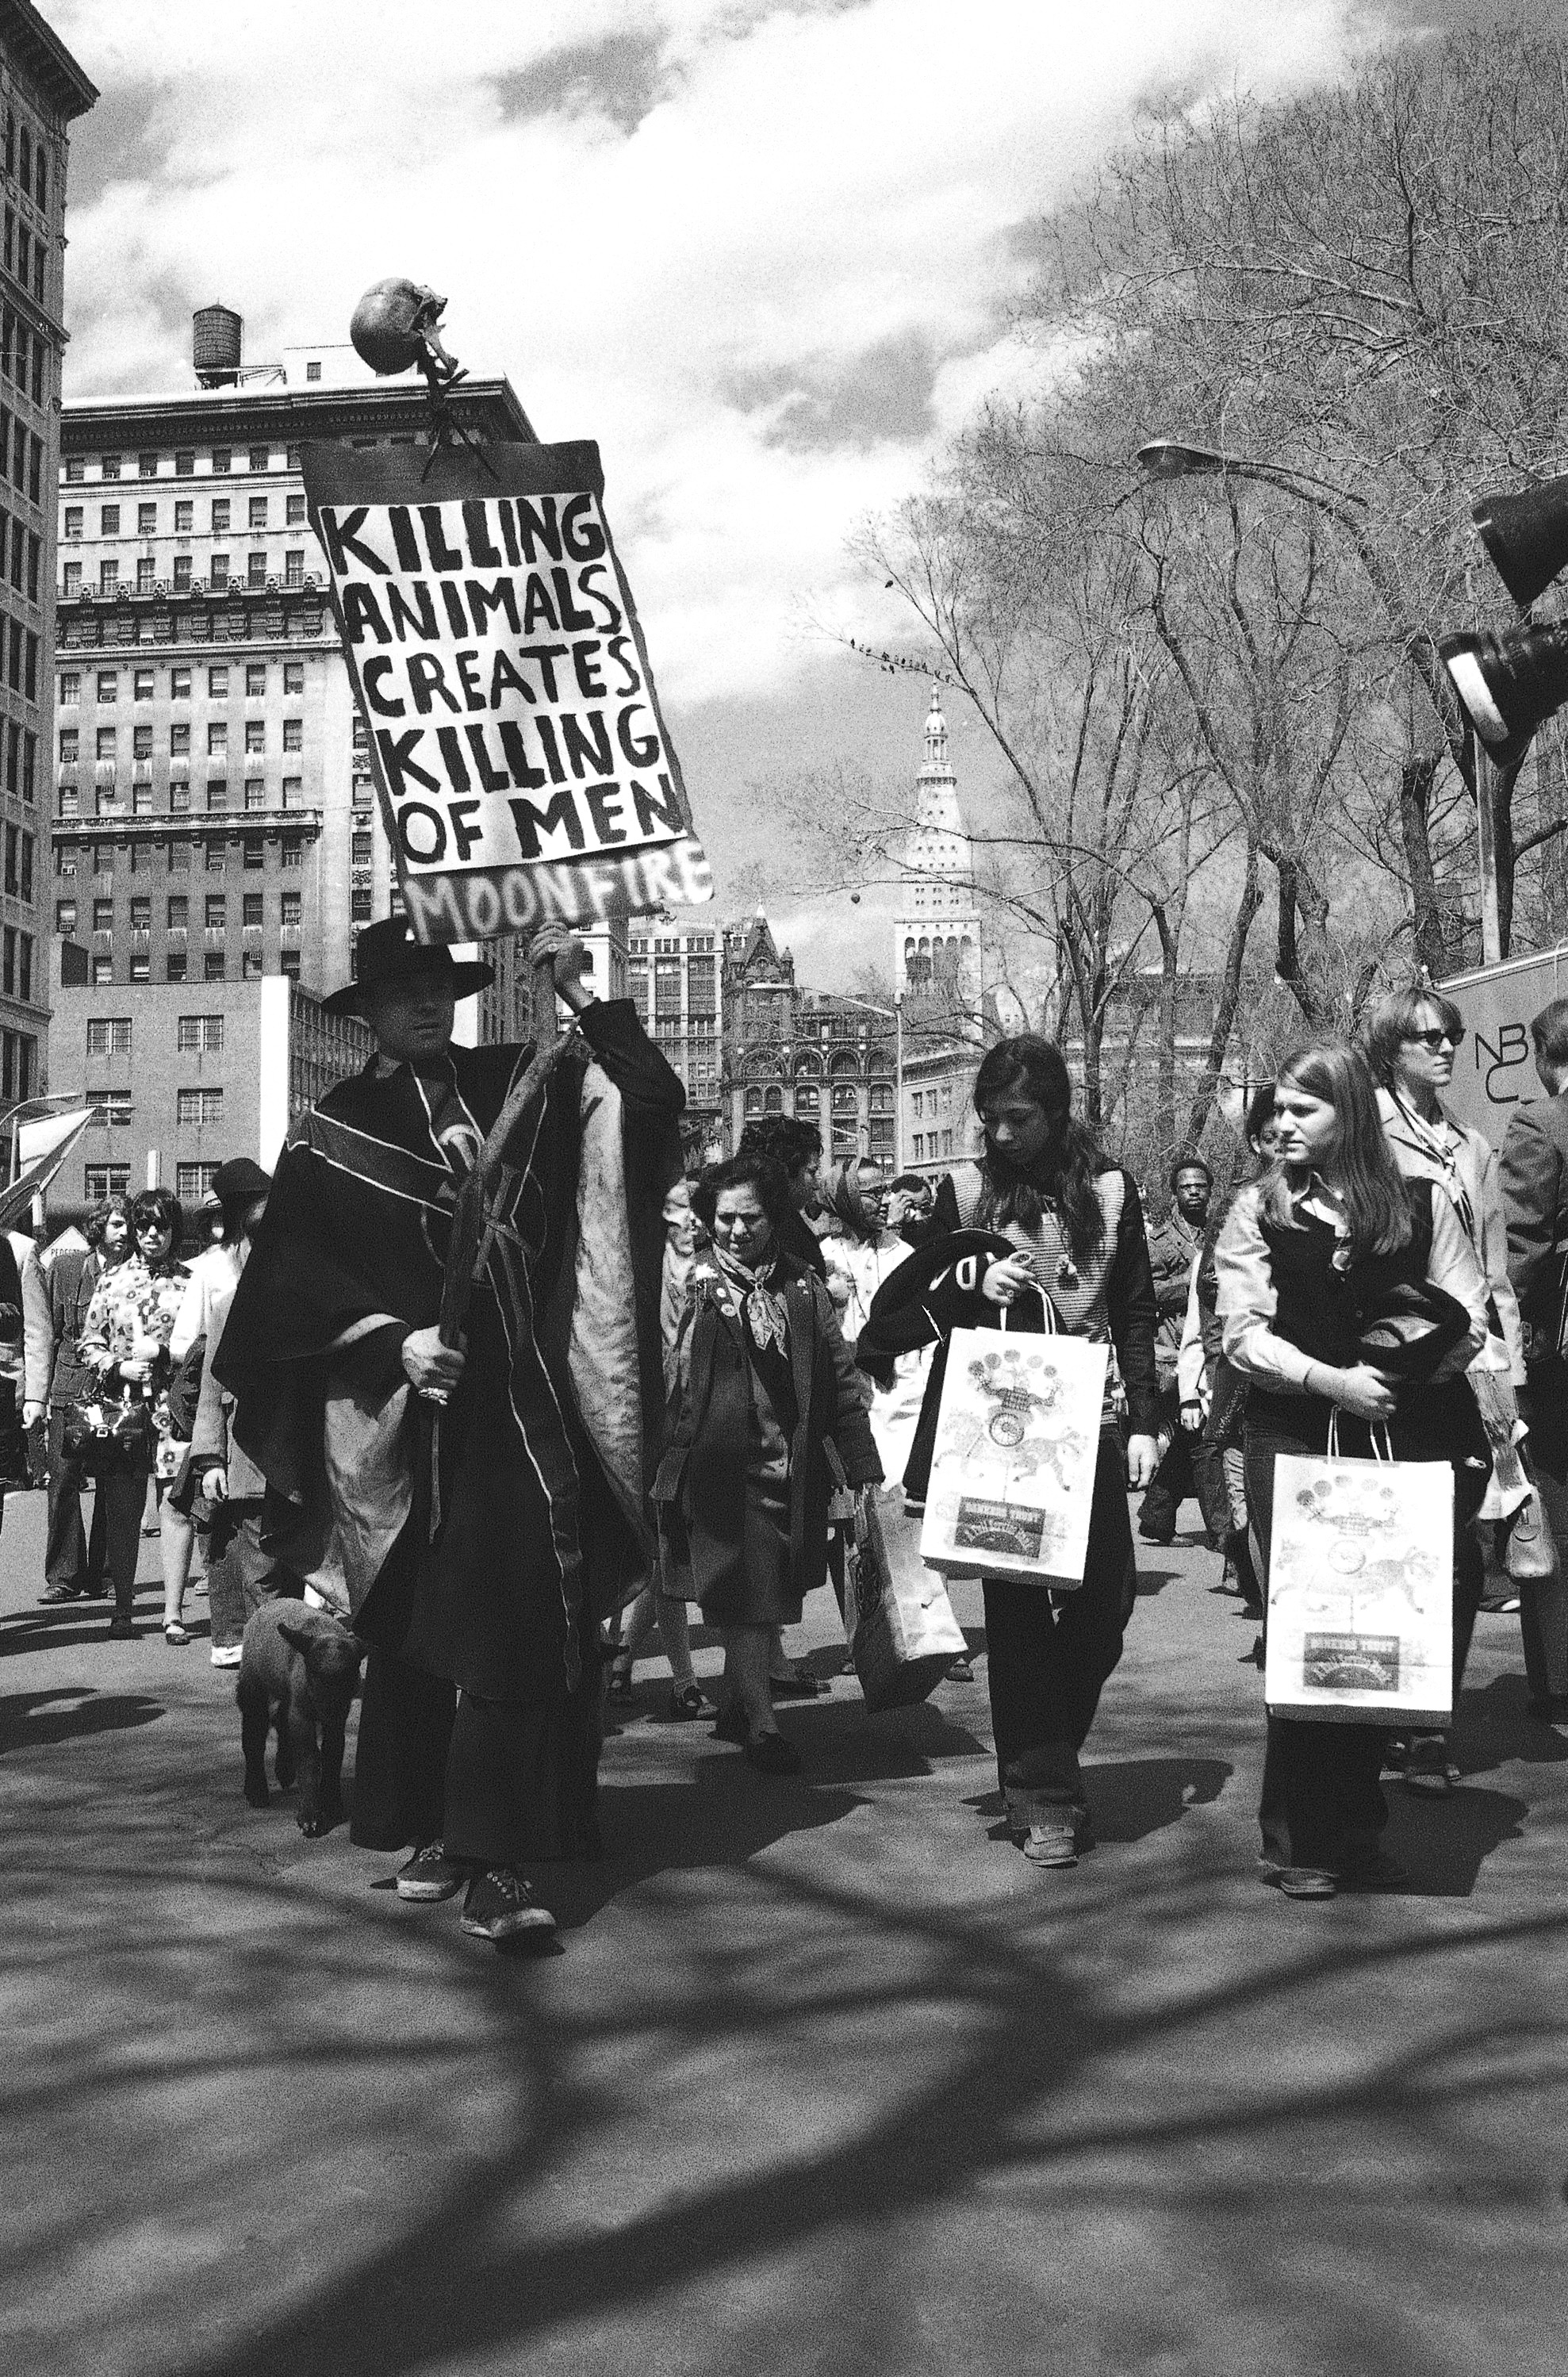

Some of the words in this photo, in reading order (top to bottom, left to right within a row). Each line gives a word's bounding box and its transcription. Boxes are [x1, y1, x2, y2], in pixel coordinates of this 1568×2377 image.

[320, 493, 607, 576] KILLING
[342, 564, 622, 644] ANIMALS
[362, 636, 642, 718] CREATES
[375, 704, 661, 796] KILLING
[397, 799, 484, 865] OF
[508, 773, 686, 861] MEN
[404, 838, 713, 946] MOONFIRE
[1475, 1022, 1529, 1104] NBC
